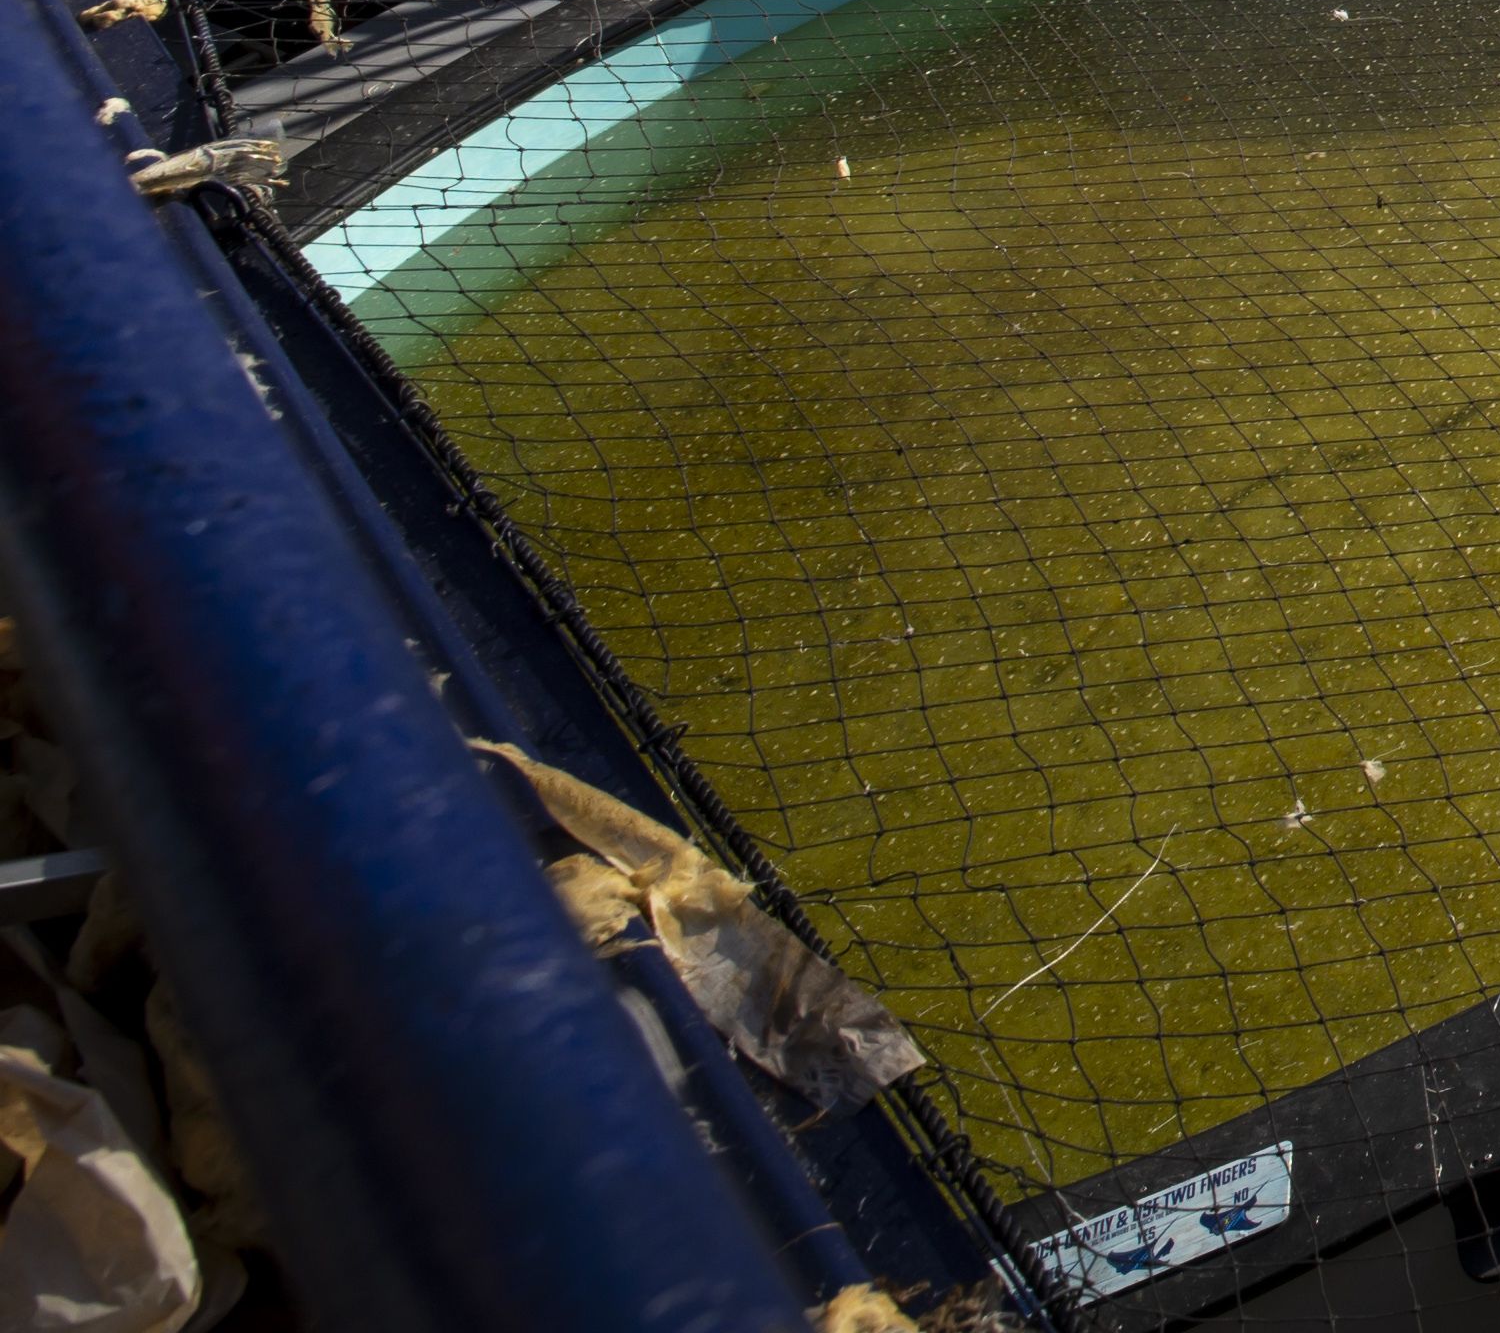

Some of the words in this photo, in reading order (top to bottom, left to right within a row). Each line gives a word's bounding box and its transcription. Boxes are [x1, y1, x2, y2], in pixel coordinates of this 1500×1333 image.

[1116, 1210, 1129, 1229] &
[1163, 1183, 1197, 1208] TWO
[1199, 1157, 1257, 1194] FINGERS
[1233, 1187, 1249, 1204] NO
